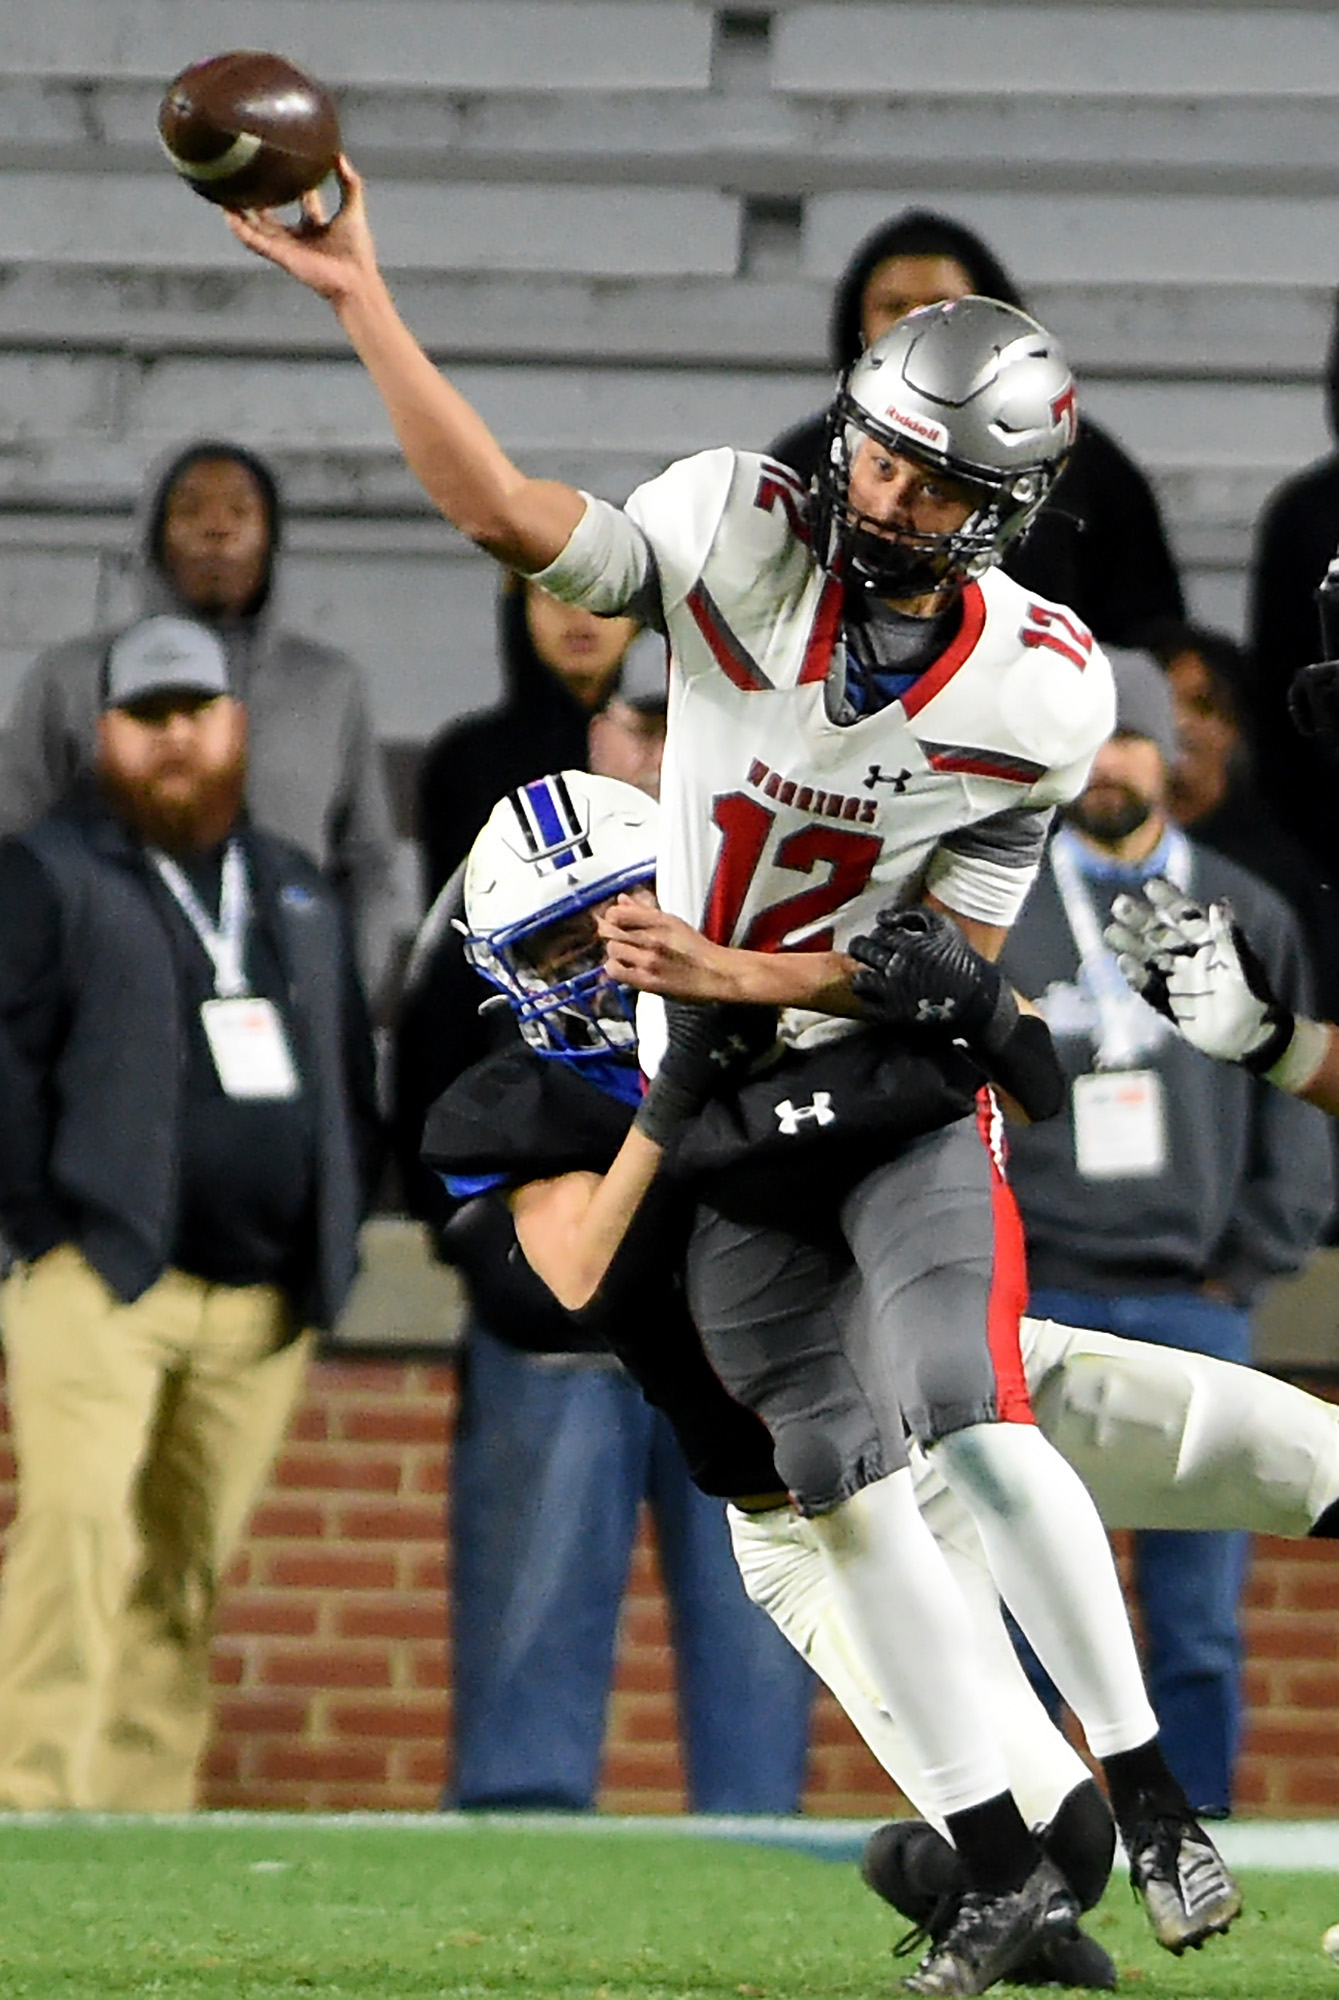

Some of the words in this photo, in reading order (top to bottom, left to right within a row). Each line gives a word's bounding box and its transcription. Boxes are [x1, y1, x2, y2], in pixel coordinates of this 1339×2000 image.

[886, 404, 940, 441] Riddell
[1017, 602, 1093, 674] 12
[700, 790, 884, 954] 12
